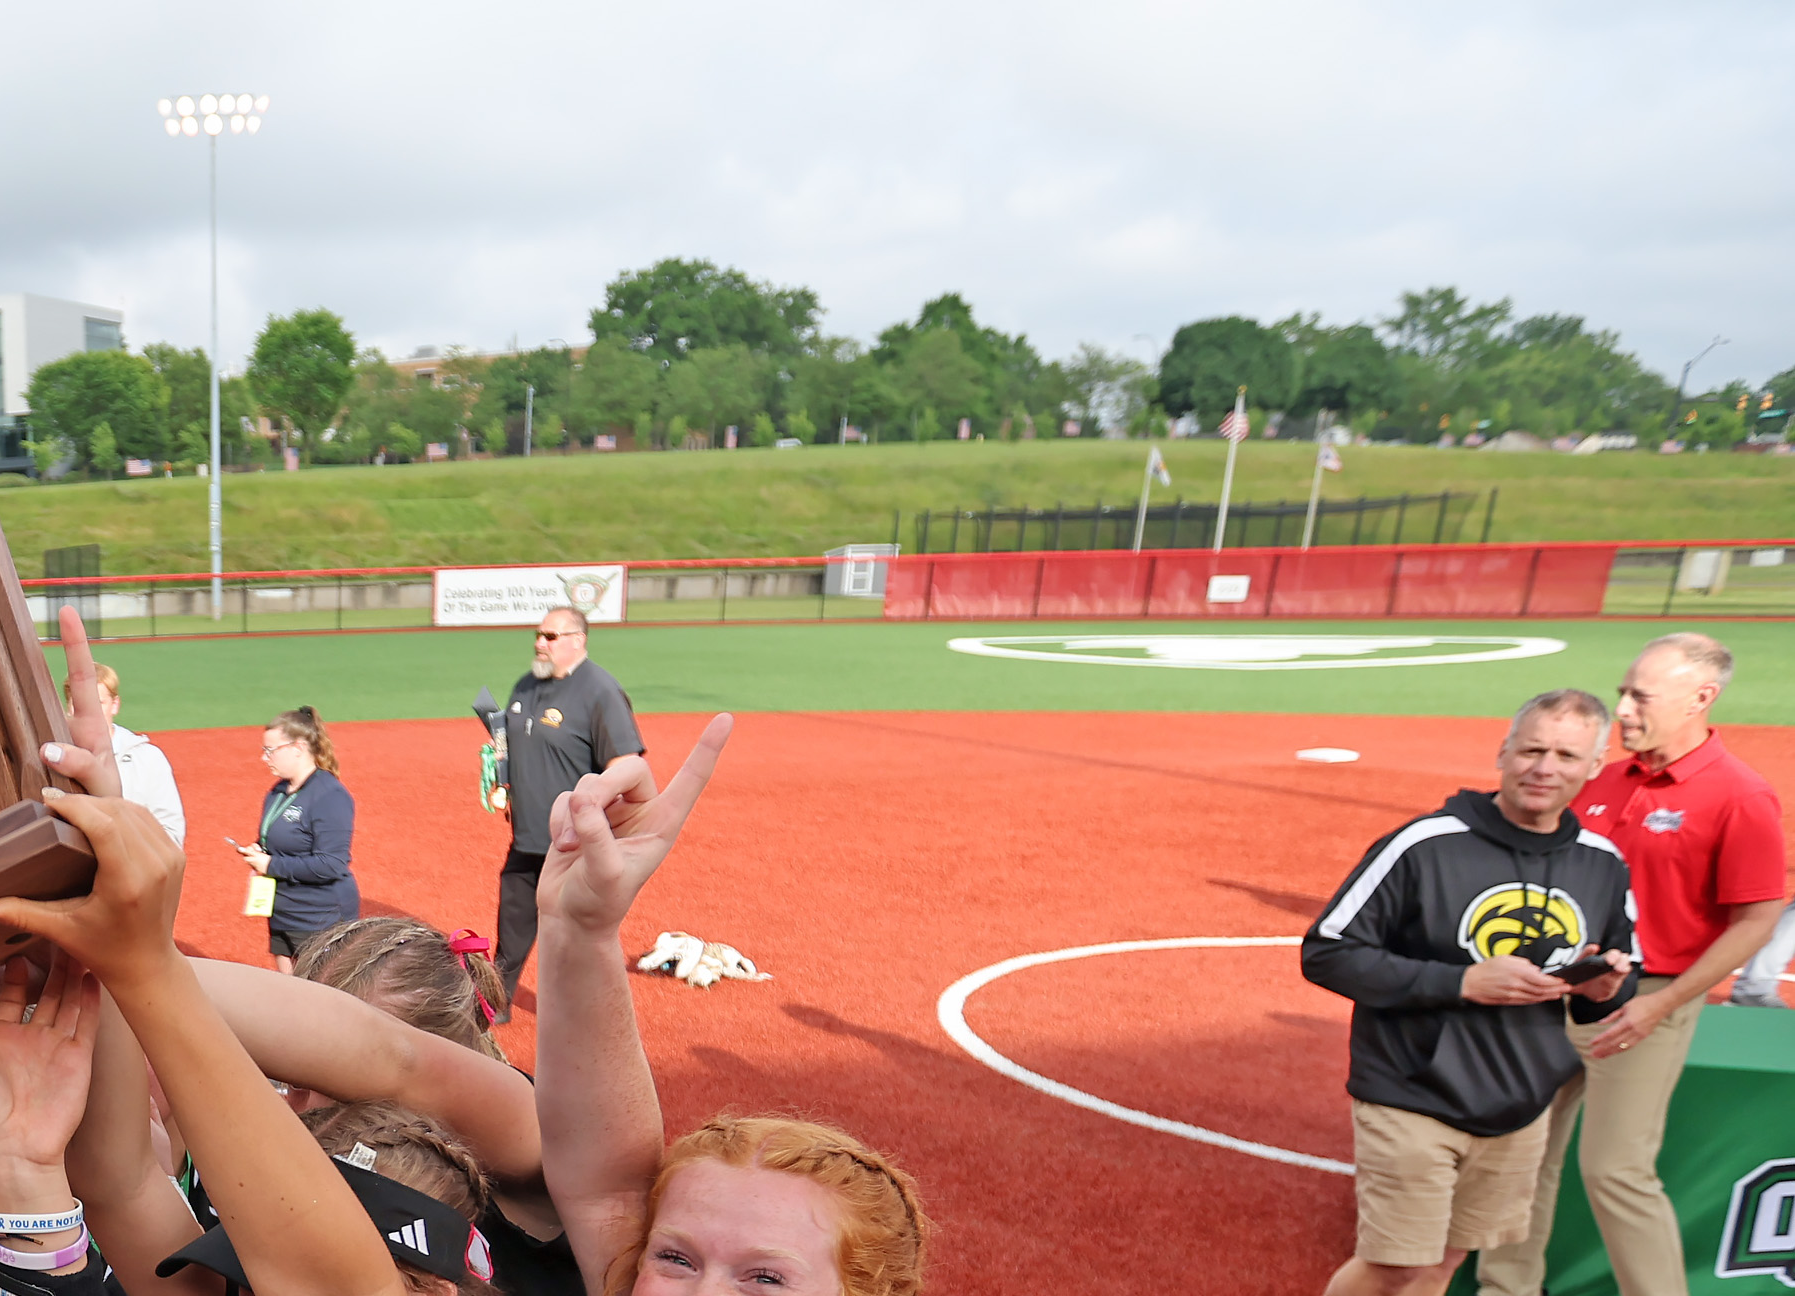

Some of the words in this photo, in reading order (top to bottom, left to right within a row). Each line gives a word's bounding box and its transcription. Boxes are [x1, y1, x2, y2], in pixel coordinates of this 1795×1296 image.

[444, 587, 503, 601] Celebrating
[507, 586, 526, 597] 100
[529, 586, 558, 597] Years
[9, 1220, 29, 1229] YOU
[32, 1219, 53, 1228] ARE
[56, 1216, 73, 1227] NOT
